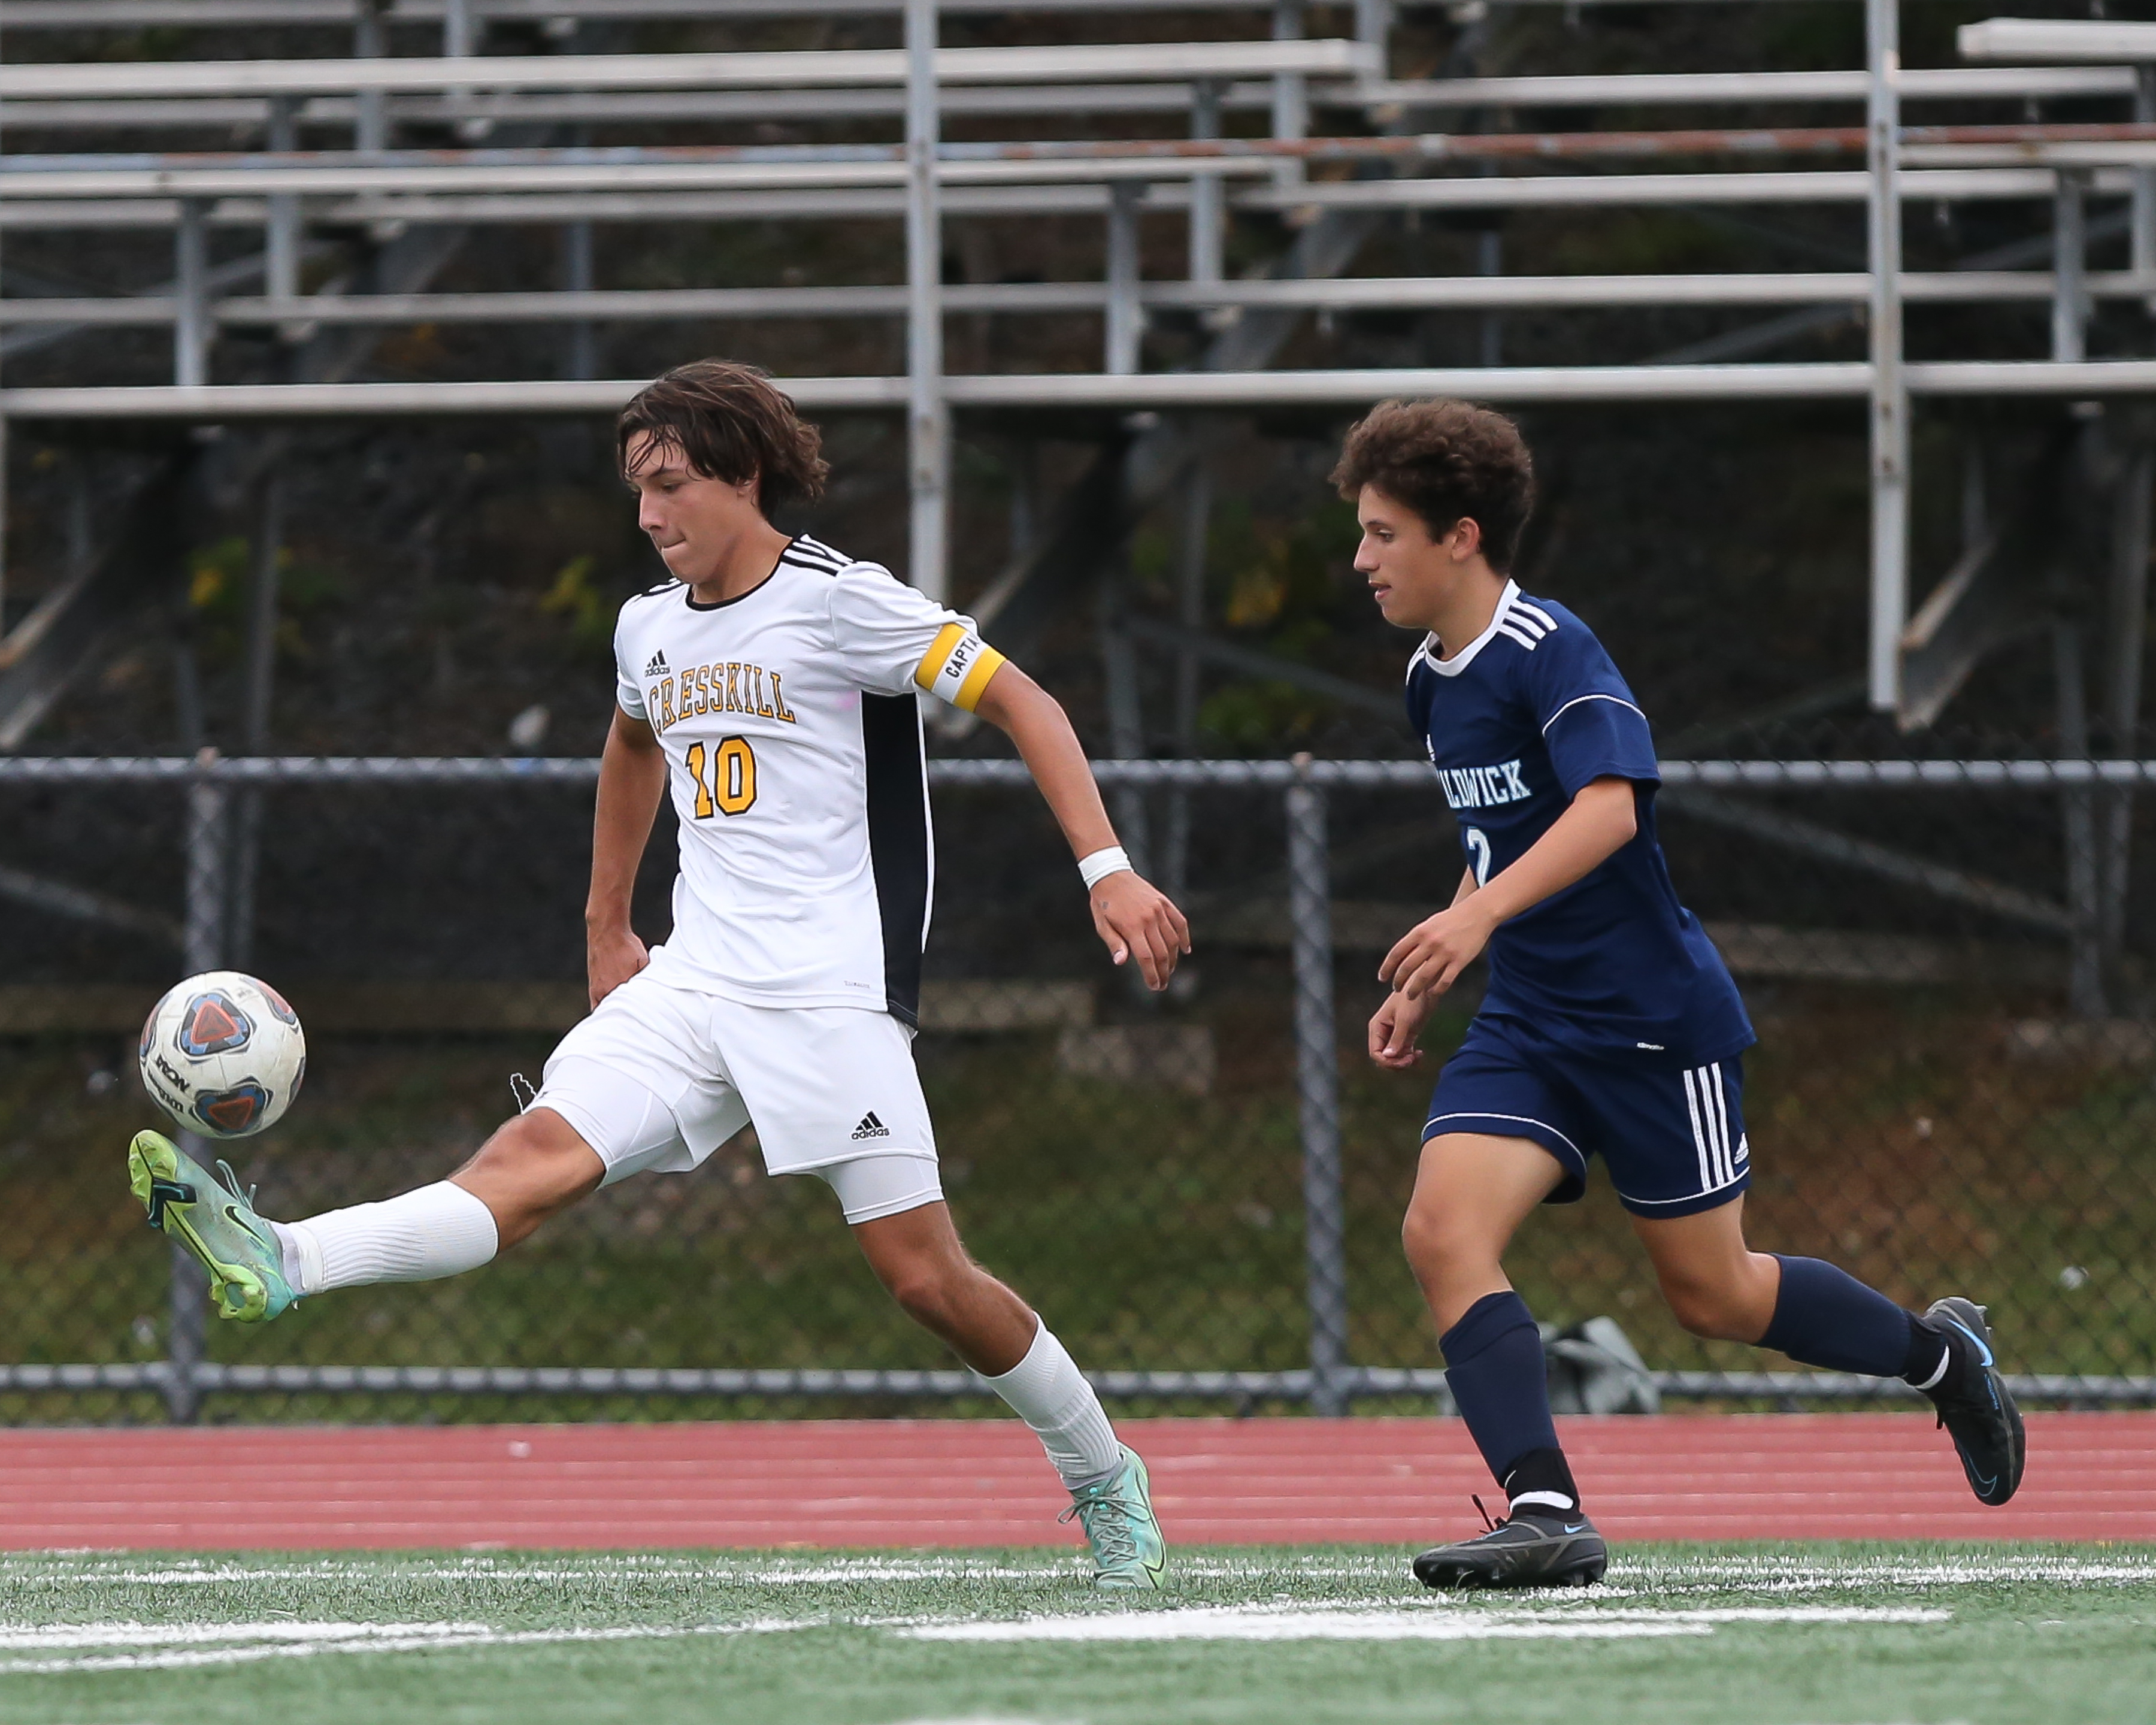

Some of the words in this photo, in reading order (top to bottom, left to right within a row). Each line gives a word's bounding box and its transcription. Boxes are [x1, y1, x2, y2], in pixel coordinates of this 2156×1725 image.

[649, 662, 797, 738] CRESSKILL
[686, 734, 756, 819] 10
[851, 1128, 890, 1140] adidas
